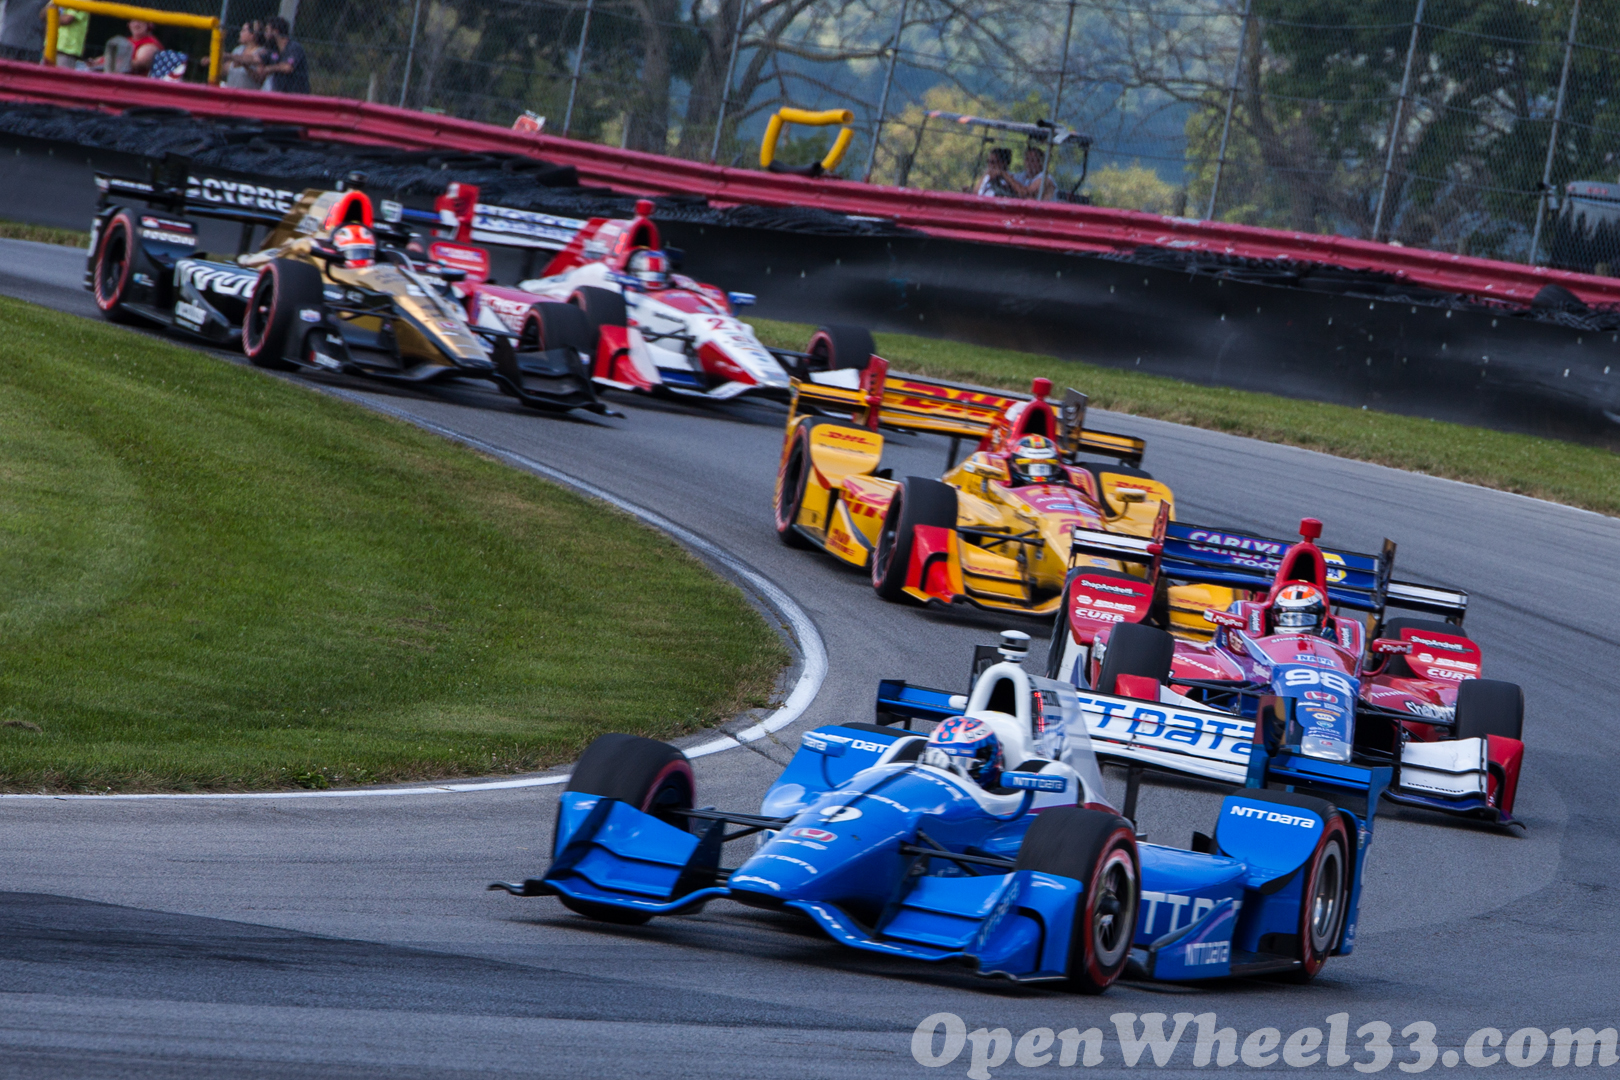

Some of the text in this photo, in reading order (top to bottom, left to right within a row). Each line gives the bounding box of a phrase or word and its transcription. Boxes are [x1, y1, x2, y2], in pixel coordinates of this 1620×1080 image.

[1188, 531, 1284, 563] CARLYL
[1075, 608, 1125, 623] CURB
[1300, 655, 1334, 666] NAPA
[1285, 668, 1353, 698] 98
[1230, 805, 1268, 820] NTT
